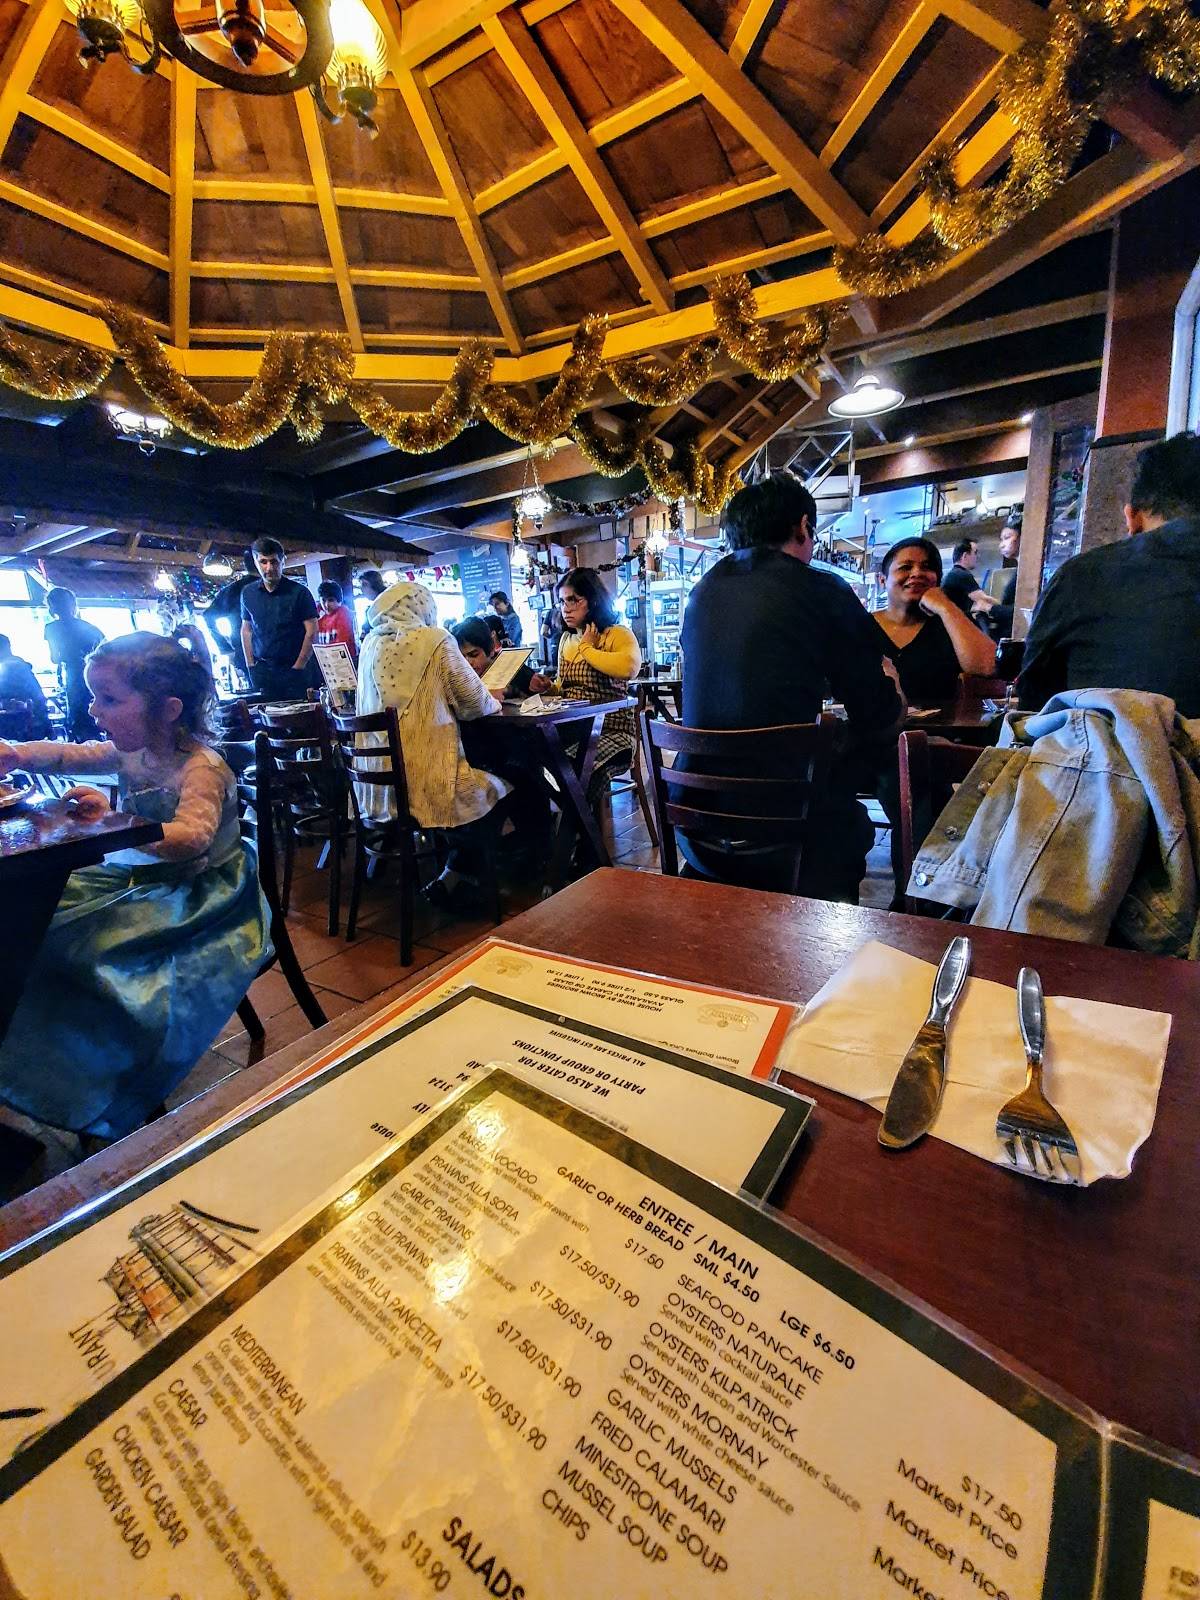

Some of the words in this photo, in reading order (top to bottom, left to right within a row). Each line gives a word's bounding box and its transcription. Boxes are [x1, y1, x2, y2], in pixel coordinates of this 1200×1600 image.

[580, 989, 605, 1000] BROWN
[617, 998, 636, 1007] WINE
[626, 995, 664, 1007] AVAILABLE
[637, 1003, 662, 1013] HOUSE
[512, 1039, 562, 1062] FUNCTIONS
[518, 1055, 538, 1068] FOR
[548, 1030, 580, 1044] INCLUSIVE
[561, 1058, 595, 1075] GROUP
[580, 1040, 593, 1049] GST
[594, 1045, 607, 1053] ARE
[607, 1049, 632, 1061] PRICES
[630, 1059, 647, 1067] ALL
[537, 1063, 567, 1079] CATER
[567, 1075, 594, 1090] ALSO
[592, 1085, 611, 1098] WE
[595, 1070, 612, 1081] OR
[610, 1077, 647, 1095] PARTY
[400, 1182, 434, 1211] GARLIC
[432, 1205, 476, 1241] PRAWNS
[429, 1154, 469, 1184] PRAWNS
[465, 1180, 491, 1202] ALLA
[489, 1195, 520, 1222] SOFIA
[556, 1165, 596, 1196] GARLIC
[596, 1190, 615, 1207] OR
[613, 1200, 644, 1227] HERB
[644, 1219, 685, 1252] BREAD
[366, 1210, 395, 1237] CHILLI
[391, 1230, 434, 1269] PRAWNS
[624, 1237, 665, 1272] $17.50
[638, 1196, 696, 1237] ENTREE
[707, 1239, 760, 1281] MAIN
[327, 1241, 370, 1280] PRAWNS
[364, 1276, 391, 1305] ALLA
[386, 1296, 444, 1353] PANCETTA
[559, 1244, 641, 1309] $17.50/$31.90
[693, 1252, 720, 1278] SML
[721, 1270, 761, 1305] $4.50
[529, 1280, 613, 1352] $17.50/$31.90
[667, 1292, 727, 1340] OYSTERS
[726, 1334, 807, 1401] NATURALE
[677, 1273, 745, 1327] SEAFOOD
[746, 1321, 824, 1385] PANCAKE
[779, 1309, 811, 1339] LGE
[812, 1331, 857, 1371] $6.50
[230, 1324, 307, 1417] MEDITERRANEAN
[496, 1319, 582, 1399] $17.50/$31.90
[649, 1322, 710, 1373] OYSTERS
[709, 1367, 800, 1443] KILPATRICK
[660, 1304, 694, 1335] Served
[694, 1329, 717, 1350] with
[718, 1349, 760, 1383] cocktail
[759, 1379, 793, 1409] sauce
[168, 1378, 208, 1430] CAESAR
[459, 1364, 548, 1452] $17.50/$31.90
[629, 1354, 691, 1410] OYSTERS
[691, 1403, 769, 1471] MORNAY
[640, 1334, 676, 1367] Served
[676, 1362, 700, 1386] with
[701, 1380, 736, 1415] bacon
[736, 1410, 761, 1434] and
[821, 1474, 862, 1513] Sauce
[590, 1410, 634, 1454] FRIED
[634, 1449, 726, 1535] CALAMARI
[607, 1389, 665, 1444] GARLIC
[664, 1436, 738, 1505] MUSSELS
[620, 1368, 656, 1401] Served
[656, 1397, 682, 1424] with
[682, 1419, 715, 1451] white
[714, 1446, 757, 1485] cheese
[757, 1481, 795, 1516] sauce
[85, 1447, 127, 1512] GARDEN
[114, 1505, 151, 1561] SALAD
[113, 1424, 157, 1489] CHICKEN
[144, 1483, 189, 1549] CAESAR
[541, 1489, 591, 1542] CHIPS
[557, 1460, 615, 1525] MUSSEL
[617, 1515, 668, 1565] SOUP
[574, 1435, 677, 1533] MINESTRONE
[675, 1524, 728, 1575] SOUP
[897, 1457, 964, 1519] Market
[969, 1510, 1018, 1560] Price
[401, 1529, 451, 1594] $13.90
[442, 1516, 526, 1600] SALADS
[873, 1546, 944, 1600] Marke
[885, 1499, 956, 1566] Market
[960, 1557, 1010, 1600] Price
